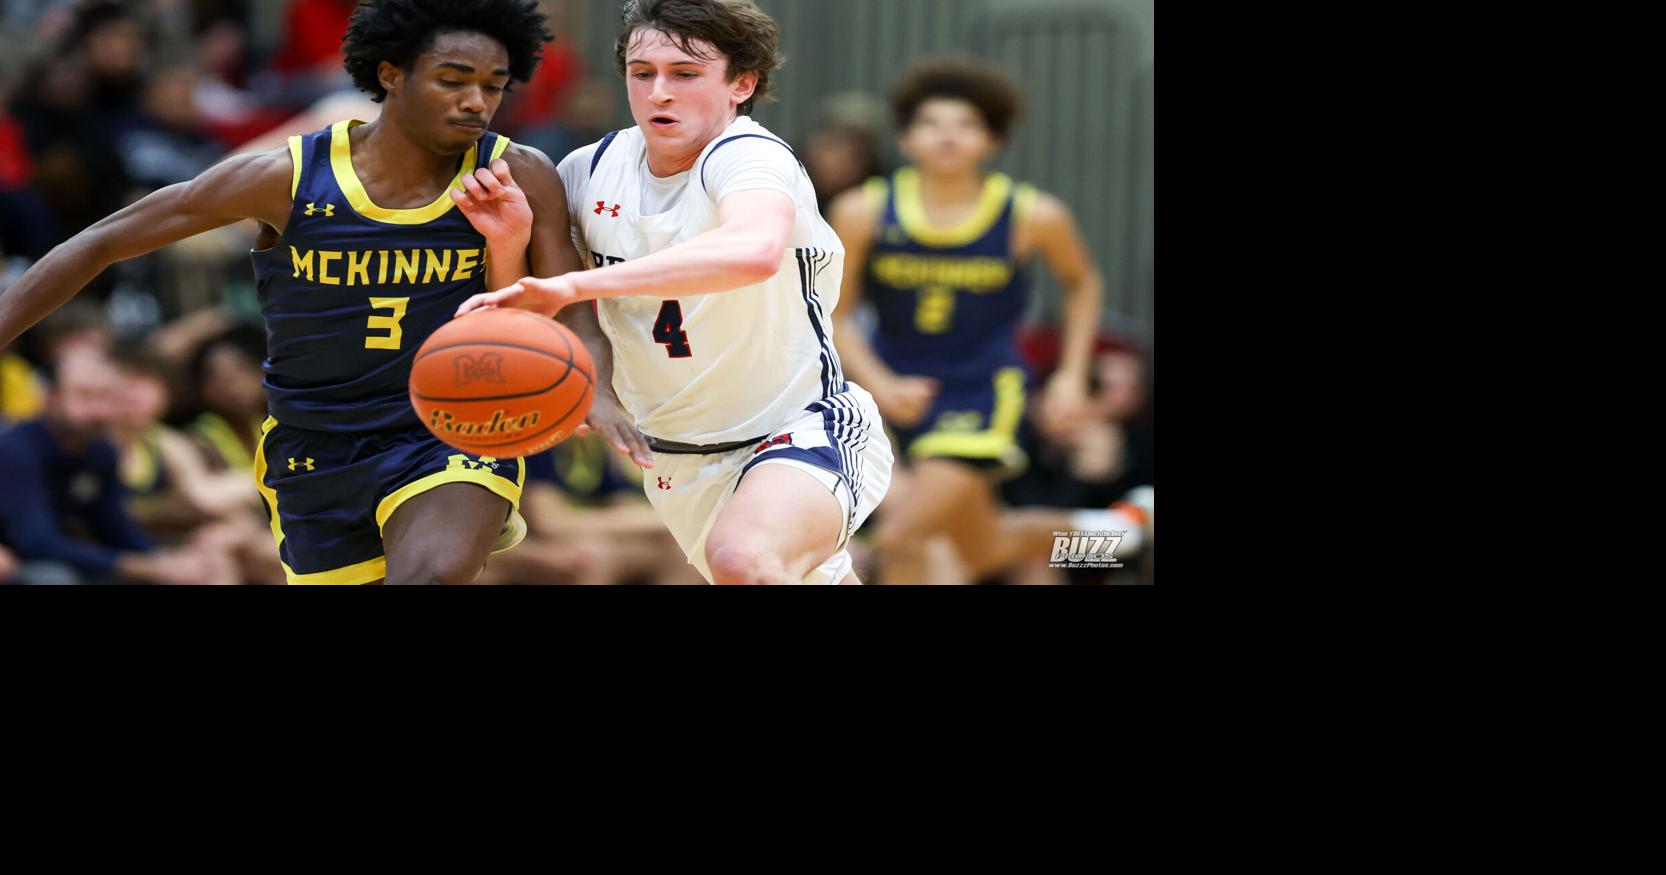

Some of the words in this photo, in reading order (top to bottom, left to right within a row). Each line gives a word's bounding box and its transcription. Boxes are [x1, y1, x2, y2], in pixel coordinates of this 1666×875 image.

[290, 245, 487, 286] MCKINNE
[364, 296, 410, 350] 3
[652, 299, 692, 358] 4
[430, 408, 541, 435] Baden
